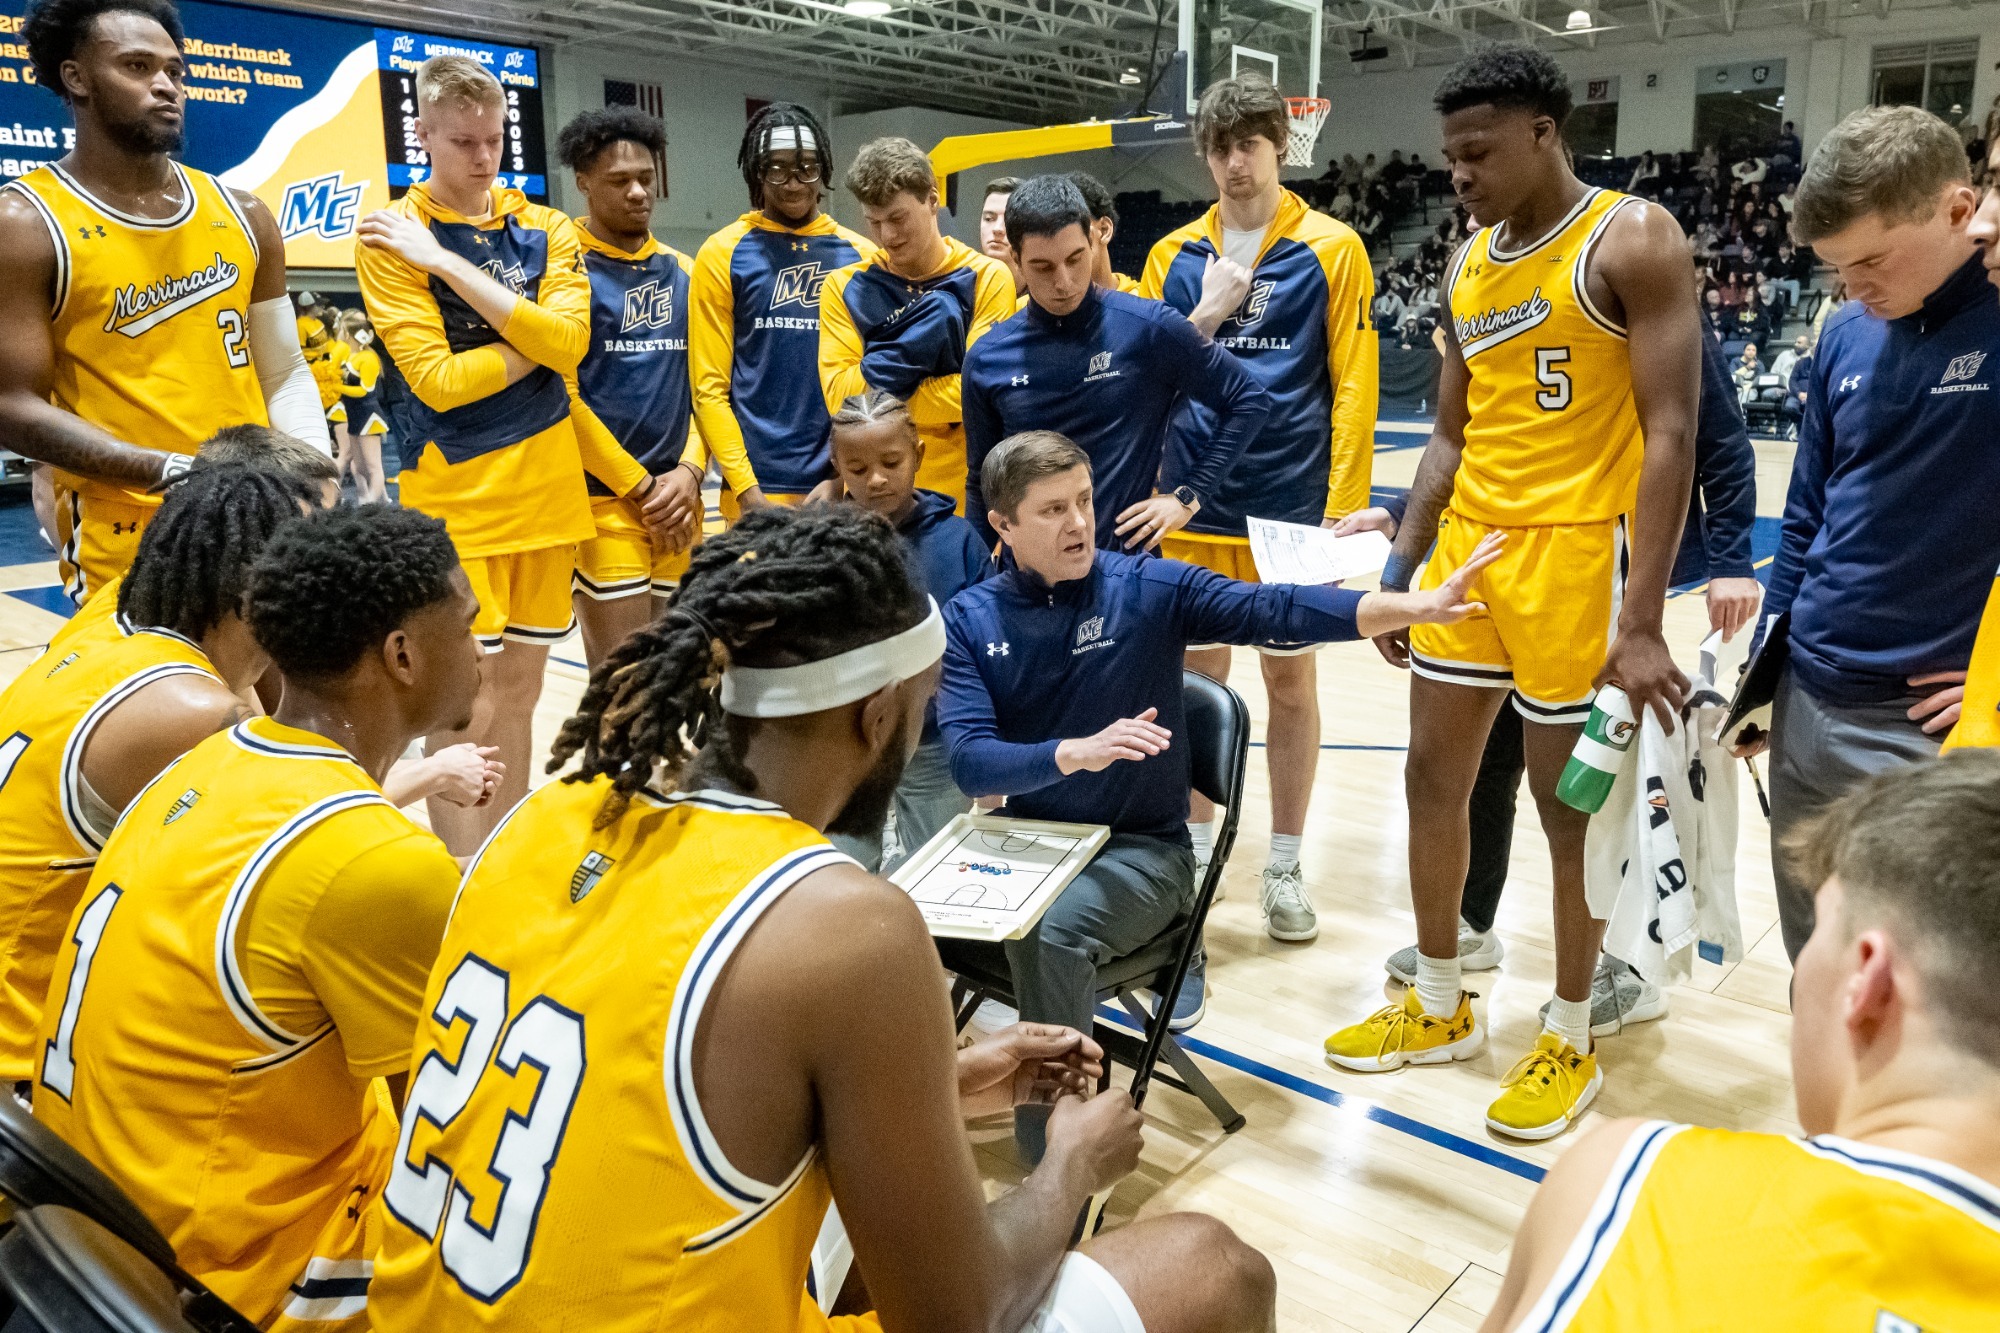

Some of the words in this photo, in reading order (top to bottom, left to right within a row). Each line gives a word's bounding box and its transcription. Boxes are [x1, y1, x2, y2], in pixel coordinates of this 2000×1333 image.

[183, 38, 292, 66] Merrimack
[424, 43, 494, 64] MERRIMACK
[189, 62, 252, 83] which
[254, 69, 304, 89] team
[500, 70, 535, 87] Points
[1646, 74, 1657, 87] 2
[400, 78, 410, 94] 1
[507, 90, 519, 106] 2
[401, 99, 414, 114] 4
[508, 108, 520, 123] 0
[510, 125, 521, 140] 0
[405, 149, 428, 165] 24
[513, 156, 524, 171] 3
[511, 141, 522, 155] 5
[103, 252, 239, 333] Merrimack
[620, 280, 673, 333] MC
[604, 339, 688, 352] BASKETBAL
[1535, 346, 1572, 411] 5
[1930, 383, 1990, 394] BASKETBALL
[41, 882, 123, 1103] 1
[384, 951, 587, 1304] 23
